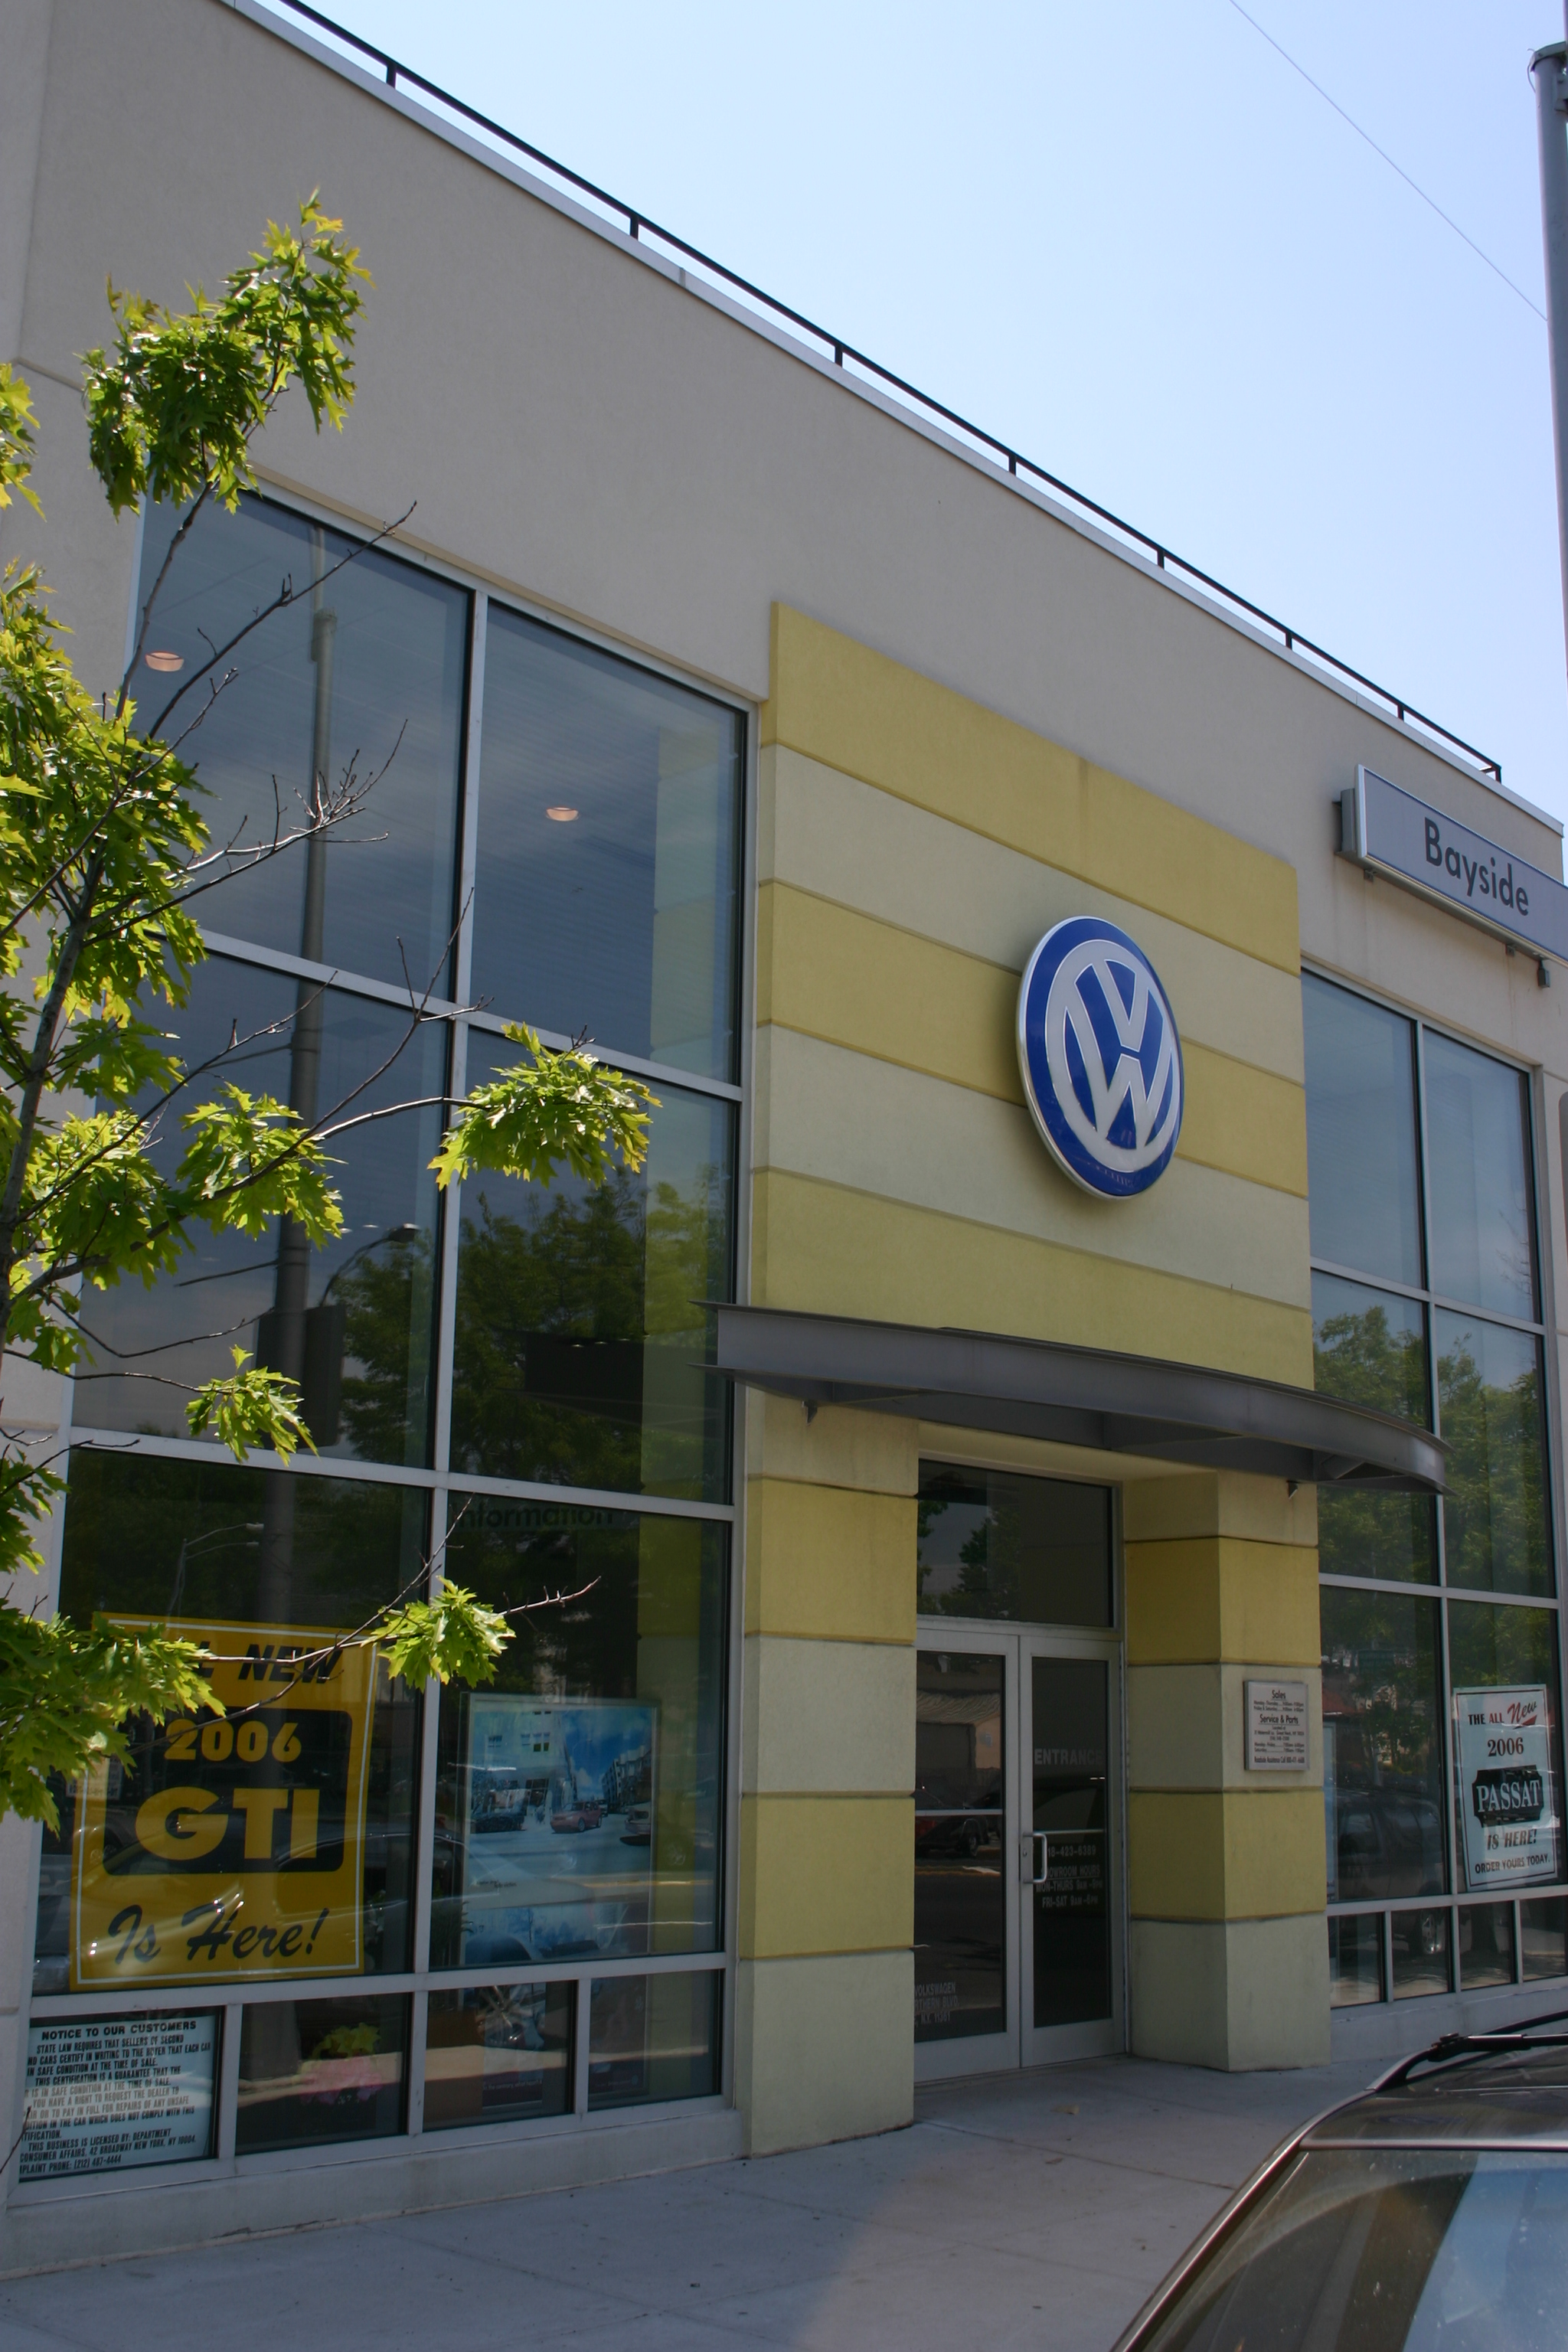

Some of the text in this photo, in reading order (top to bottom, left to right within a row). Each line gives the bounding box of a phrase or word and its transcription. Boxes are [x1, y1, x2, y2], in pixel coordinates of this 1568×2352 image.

[1424, 817, 1529, 916] Bayside
[238, 1643, 345, 1684] NEW
[1272, 1690, 1285, 1699] Sales
[1259, 1713, 1298, 1724] Service & Parts
[1468, 1701, 1537, 1725] THE ALL New
[164, 1718, 302, 1762] 2006
[1488, 1737, 1524, 1757] 2006
[1034, 1749, 1103, 1765] ENTRANCE
[1476, 1779, 1540, 1813] PASSAT
[136, 1785, 320, 1860] GTI
[1487, 1828, 1537, 1851] IS HERE!
[1048, 1845, 1096, 1857] 18-423-6389
[1041, 1866, 1077, 1878] OWROOM
[1475, 1854, 1550, 1874] ORDER YOURS TODAY.
[107, 1901, 330, 1965] Is Here!
[41, 2020, 196, 2040] NOTICE TO OUR CUSTOMERS
[37, 2034, 184, 2053] STATE LAW REQUIRES THAT SELLERS OF SECOND
[40, 2055, 57, 2065] CARS
[60, 2053, 84, 2063] CERTIFY
[87, 2052, 92, 2061] IN
[95, 2050, 119, 2060] WRITING
[122, 2049, 129, 2058] TO
[132, 2048, 142, 2056] THE
[168, 2045, 182, 2055] THAT
[185, 2043, 199, 2053] EACH
[201, 2042, 211, 2052] CAR
[27, 2058, 158, 2076] IN SAFE CONDITION AT THE TIME OF SALE.
[36, 2066, 181, 2086] THIS CERTIFICATION IS A GUARANTEE THAT THE
[32, 2089, 38, 2097] IS
[41, 2088, 48, 2096] IN
[52, 2086, 67, 2096] SAFE
[70, 2082, 101, 2095] CONDITION
[105, 2082, 112, 2090] AT
[115, 2081, 125, 2091] THE
[129, 2079, 142, 2088] TIME
[145, 2079, 152, 2087] OF
[34, 2099, 46, 2108] YOU
[49, 2097, 64, 2106] HAVE
[68, 2096, 72, 2105] A
[75, 2094, 92, 2104] RIGHT
[95, 2093, 102, 2102] TO
[105, 2091, 131, 2102] REQUEST
[135, 2090, 145, 2099] THE
[148, 2087, 169, 2097] DEALER
[40, 2110, 49, 2118] OR
[52, 2109, 60, 2118] TO
[63, 2107, 75, 2117] PAY
[77, 2106, 83, 2115] IN
[87, 2104, 99, 2115] FULL
[103, 2103, 113, 2113] FOR
[116, 2101, 142, 2113] REPAIRS
[144, 2100, 151, 2109] OF
[154, 2099, 165, 2108] ANY
[168, 2096, 189, 2105] UNSAFE
[51, 2119, 57, 2128] IN
[60, 2118, 71, 2128] THE
[74, 2118, 86, 2126] CAR
[89, 2115, 108, 2125] WHICH
[111, 2113, 126, 2122] DOES
[128, 2112, 139, 2121] NOT
[142, 2109, 164, 2119] COMPLY
[166, 2107, 180, 2117] WITH
[183, 2105, 195, 2115] THIS
[21, 2129, 61, 2141] TIFICATION.
[28, 2128, 171, 2151] THIS BUSINESS IS LICENSED BY: DEPARTMENT
[20, 2151, 57, 2162] CONSUMER
[90, 2147, 98, 2155] 42
[100, 2143, 132, 2154] BROADWAY
[134, 2141, 148, 2150] NEW
[168, 2137, 176, 2145] NY
[20, 2154, 122, 2174] PLAINT PHONE: (212) 487-4444
